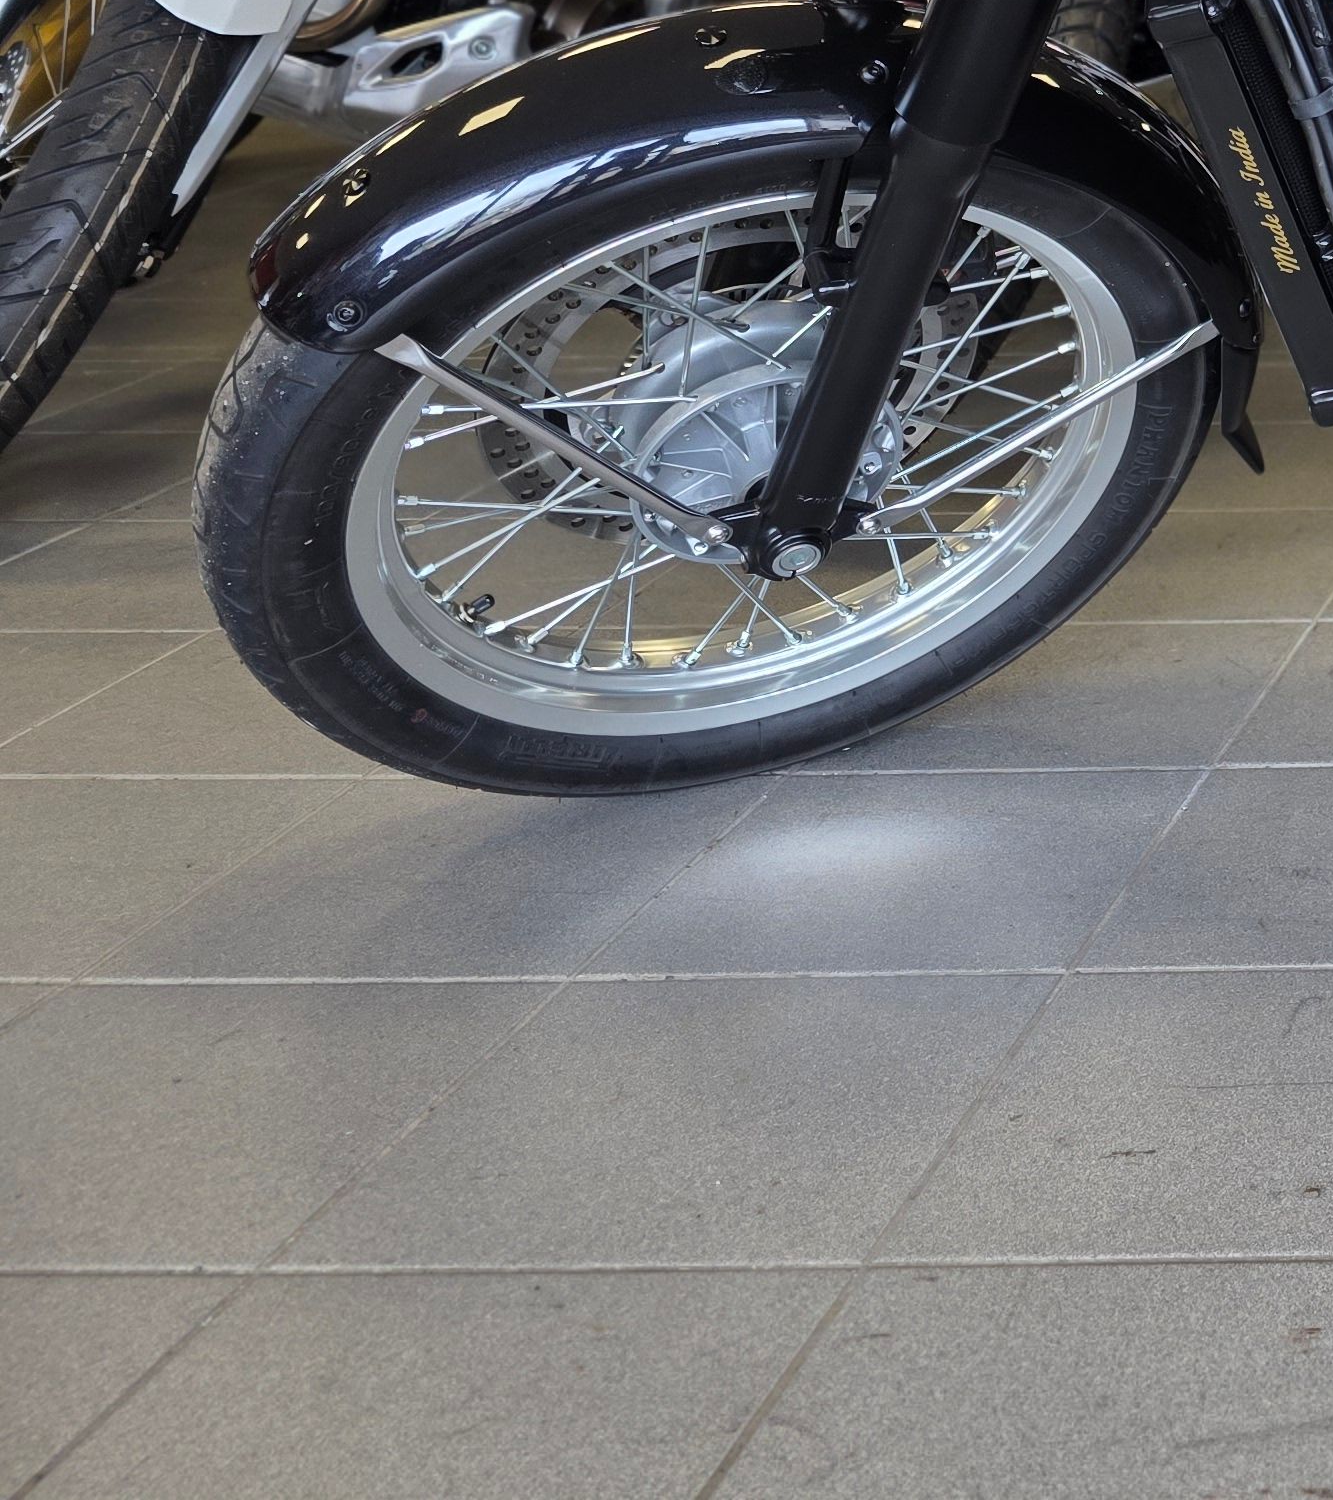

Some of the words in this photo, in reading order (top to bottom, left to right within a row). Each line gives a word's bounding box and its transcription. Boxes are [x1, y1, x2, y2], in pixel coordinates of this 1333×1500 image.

[1228, 125, 1265, 187] India
[1254, 190, 1274, 210] in
[1260, 213, 1301, 274] Made
